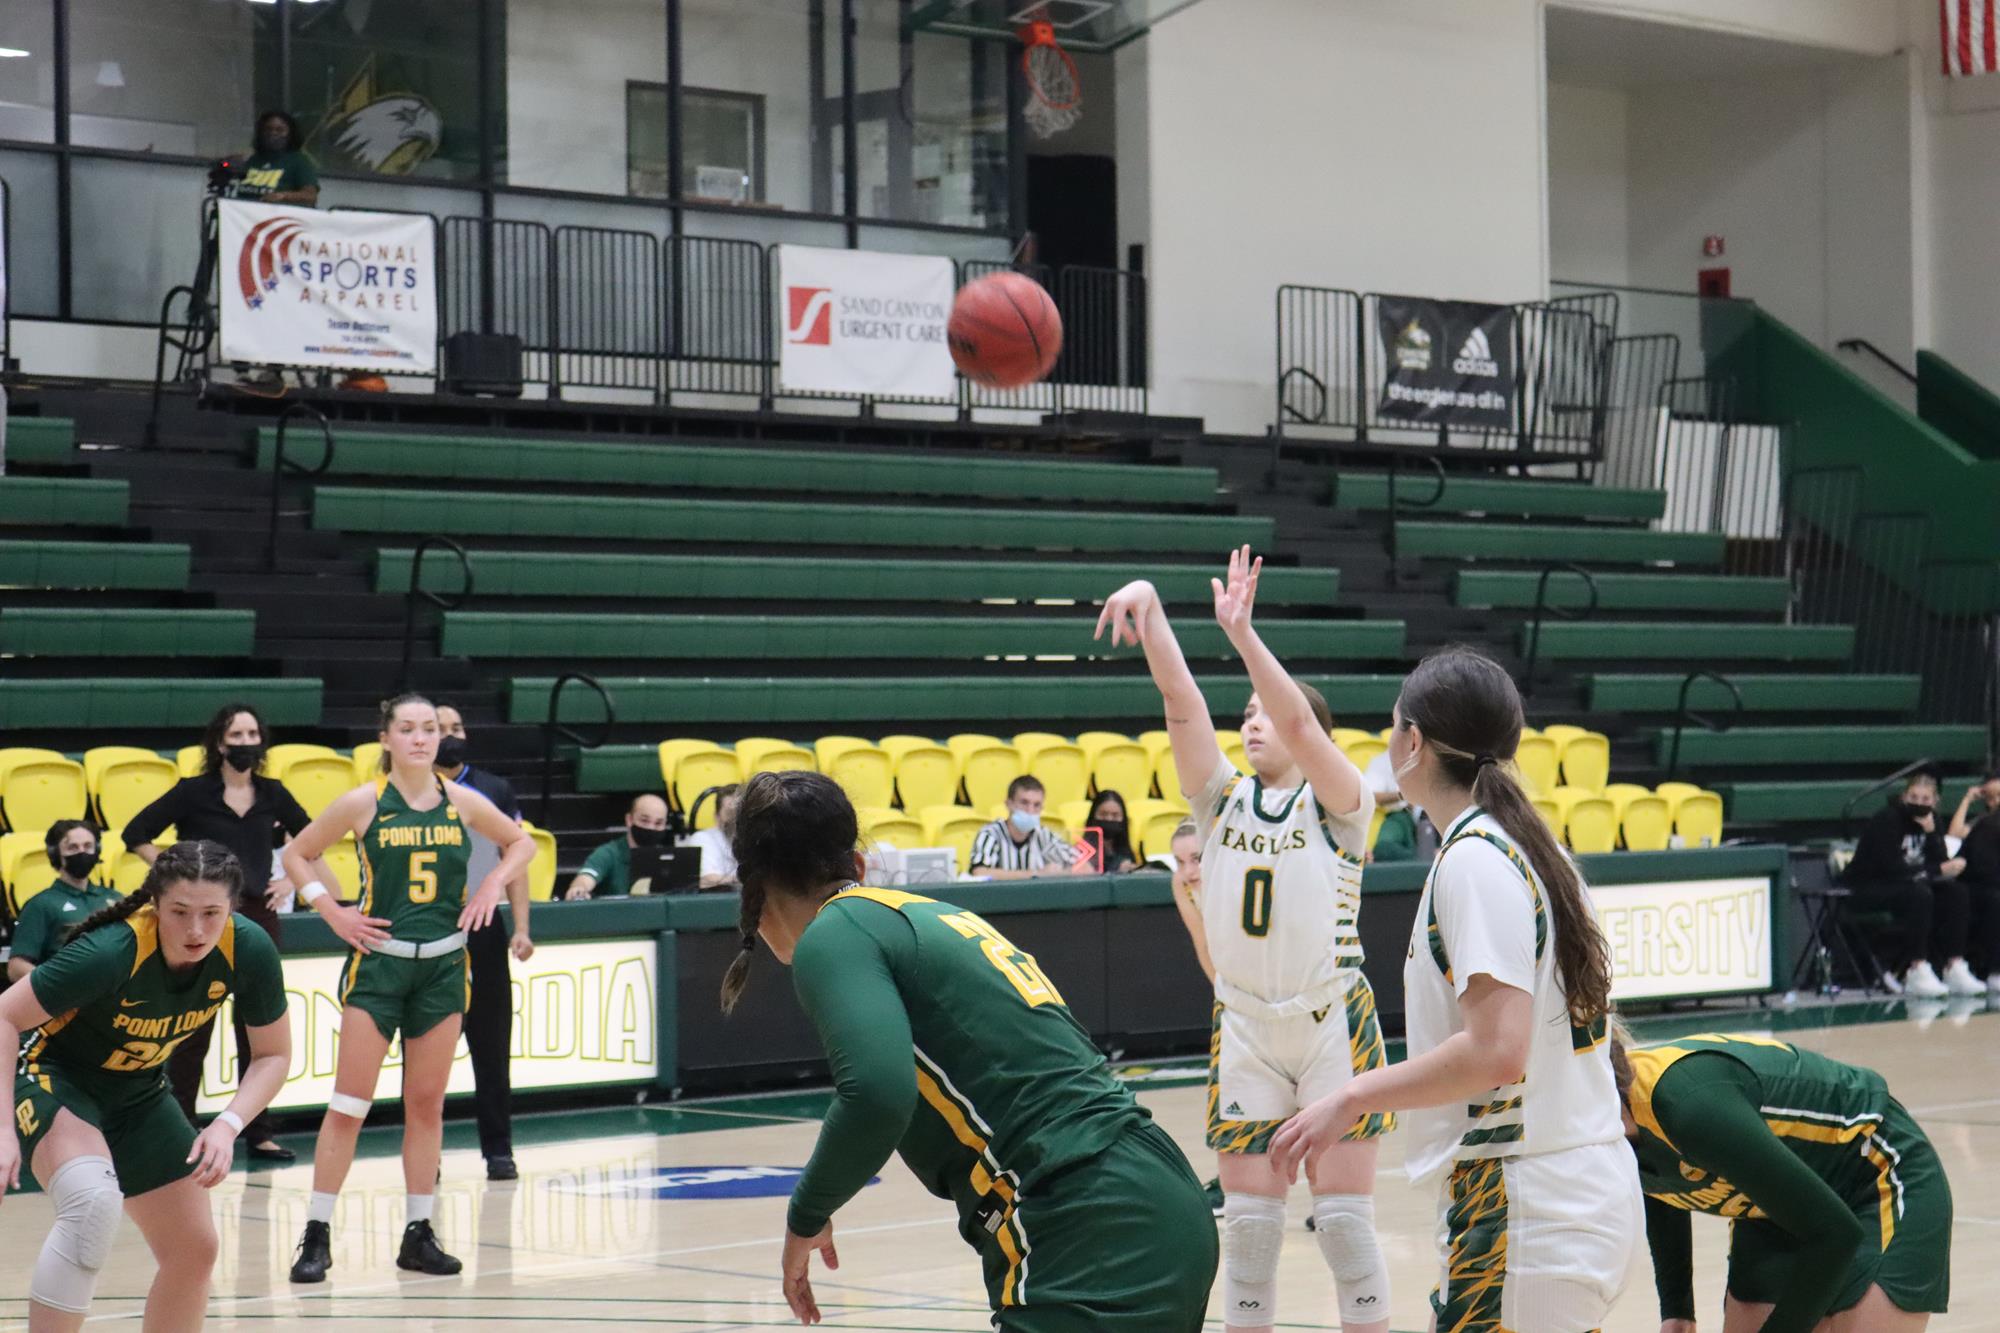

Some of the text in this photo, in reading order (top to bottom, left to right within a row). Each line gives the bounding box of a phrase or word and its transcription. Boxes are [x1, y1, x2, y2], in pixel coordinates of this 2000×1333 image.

[298, 240, 418, 262] NATIONAL
[299, 258, 417, 290] SPORTS
[299, 287, 418, 311] APPAREL
[840, 296, 944, 319] SAND CANYON
[840, 320, 944, 342] URGENT CARE
[1453, 359, 1498, 377] adidas
[378, 826, 463, 848] POINT LOMA
[409, 851, 438, 903] 5
[1242, 866, 1275, 939] 0
[1603, 888, 1766, 979] ERSITY
[112, 1013, 173, 1039] POINT
